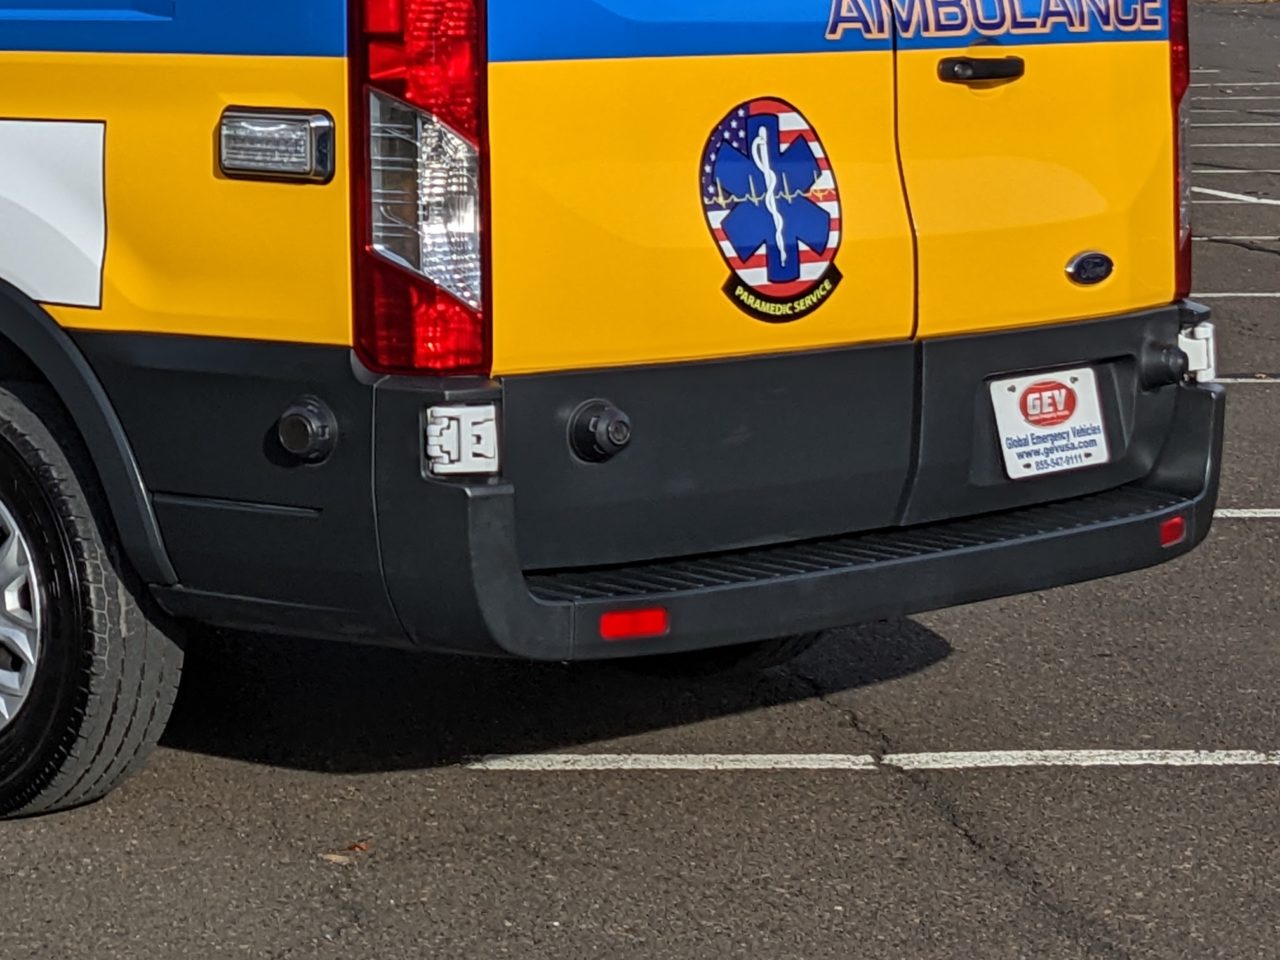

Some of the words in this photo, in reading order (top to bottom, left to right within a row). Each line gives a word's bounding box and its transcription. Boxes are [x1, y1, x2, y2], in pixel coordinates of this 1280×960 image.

[734, 285, 793, 316] PARAMEDIC
[793, 278, 833, 314] SERVICE
[1026, 388, 1067, 415] GEV
[1005, 434, 1030, 450] Global
[1030, 430, 1071, 446] Emergency
[1071, 424, 1102, 438] Vehicles
[1016, 438, 1098, 460] www.gevusa.com
